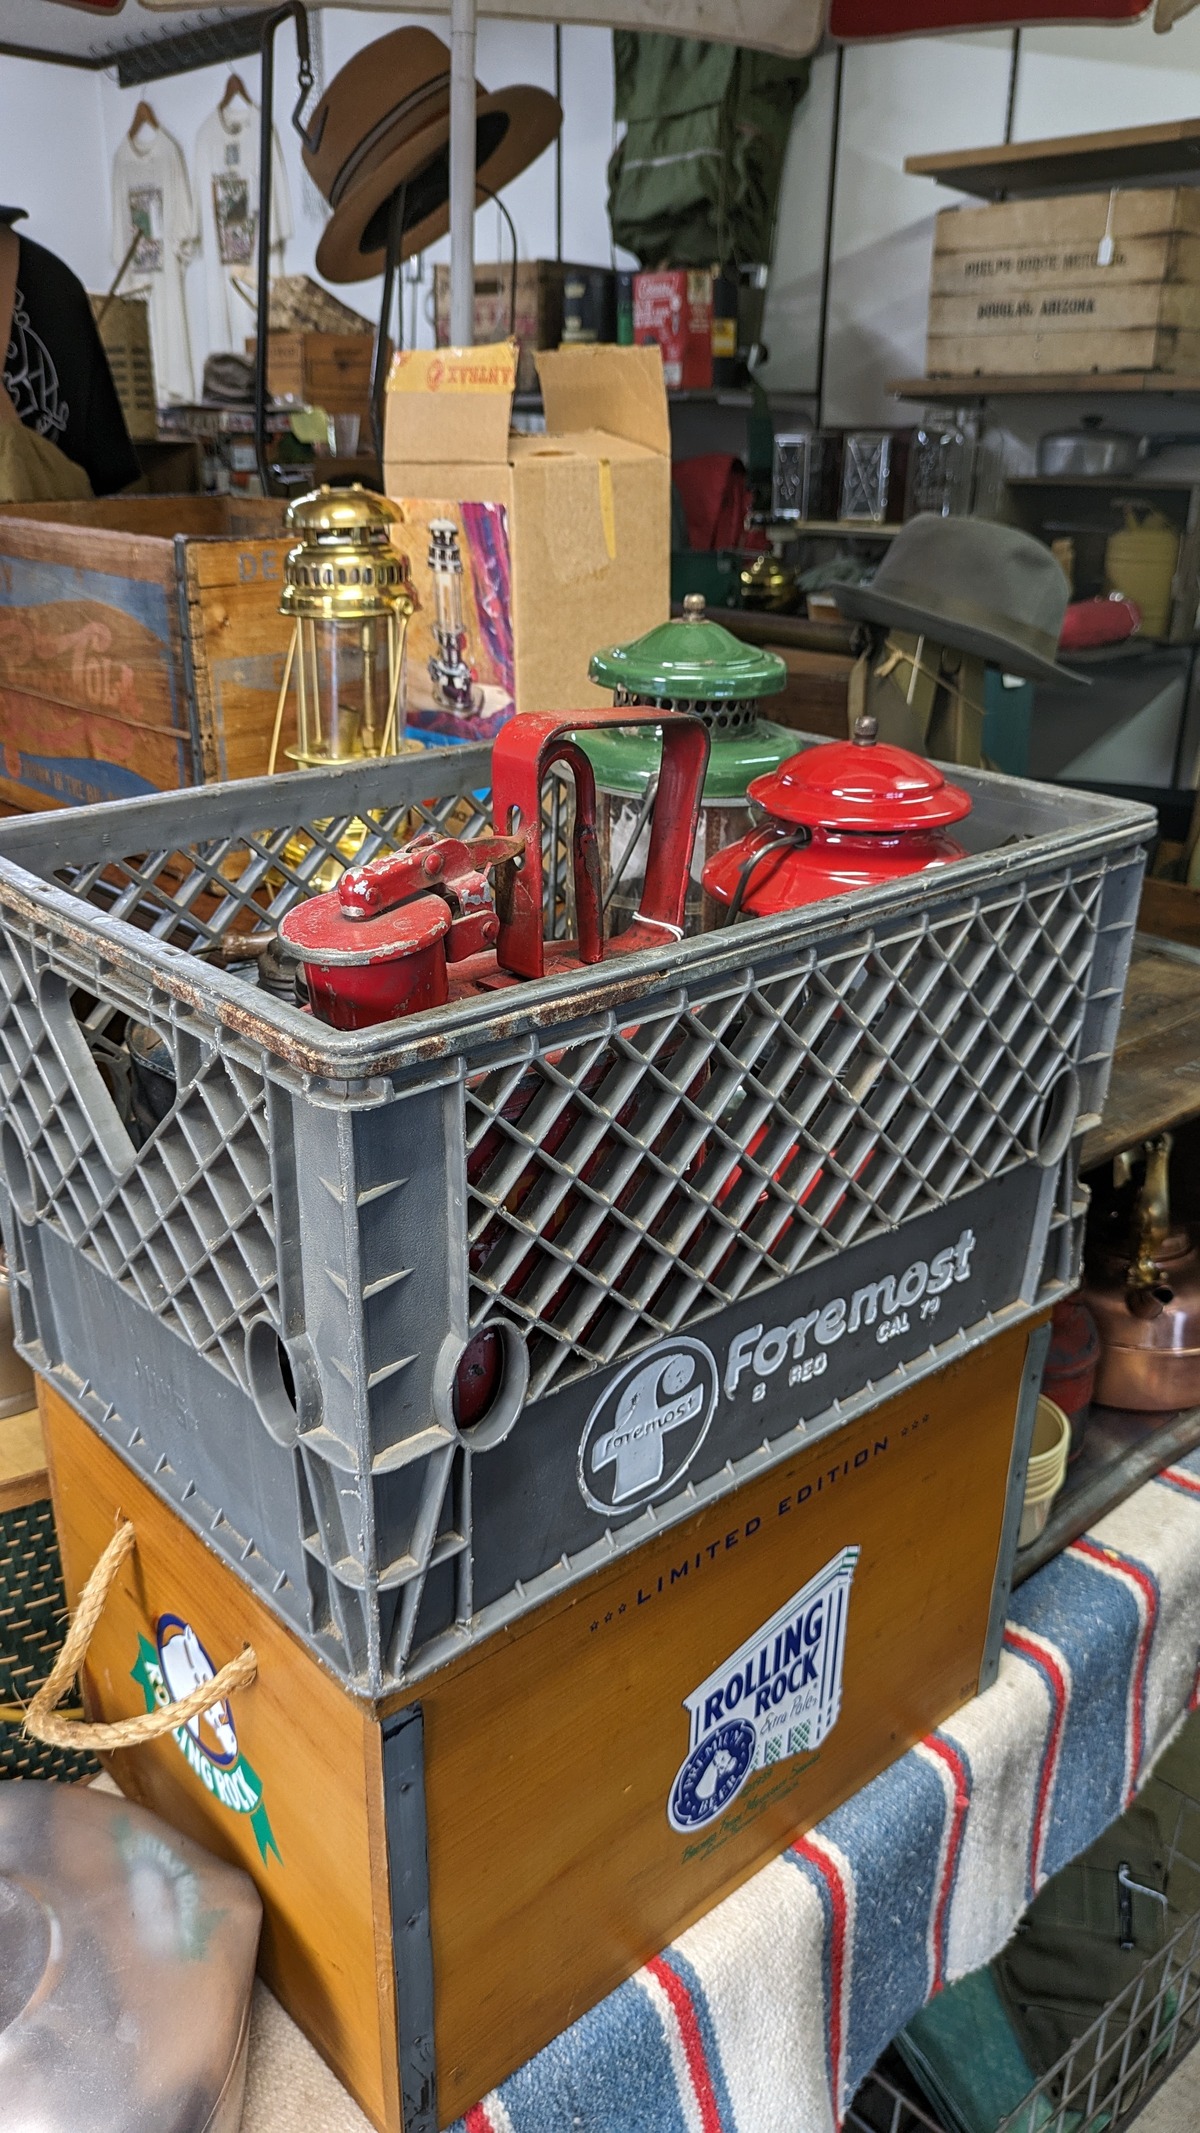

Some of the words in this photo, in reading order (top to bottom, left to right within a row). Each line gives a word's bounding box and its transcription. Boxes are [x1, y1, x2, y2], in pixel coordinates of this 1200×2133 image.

[1040, 298, 1096, 316] ARIZONA
[724, 1228, 976, 1401] Foremost
[875, 1314, 910, 1345] CAL
[637, 1516, 761, 1606] LIMITED
[778, 1436, 890, 1516] EDITION
[703, 1600, 824, 1732] ROLLING
[754, 1641, 819, 1719] ROCK
[145, 1661, 214, 1792] ROLING
[213, 1765, 259, 1812] ROCK
[683, 1729, 745, 1790] PREMIUM
[698, 1774, 738, 1815] BEER
